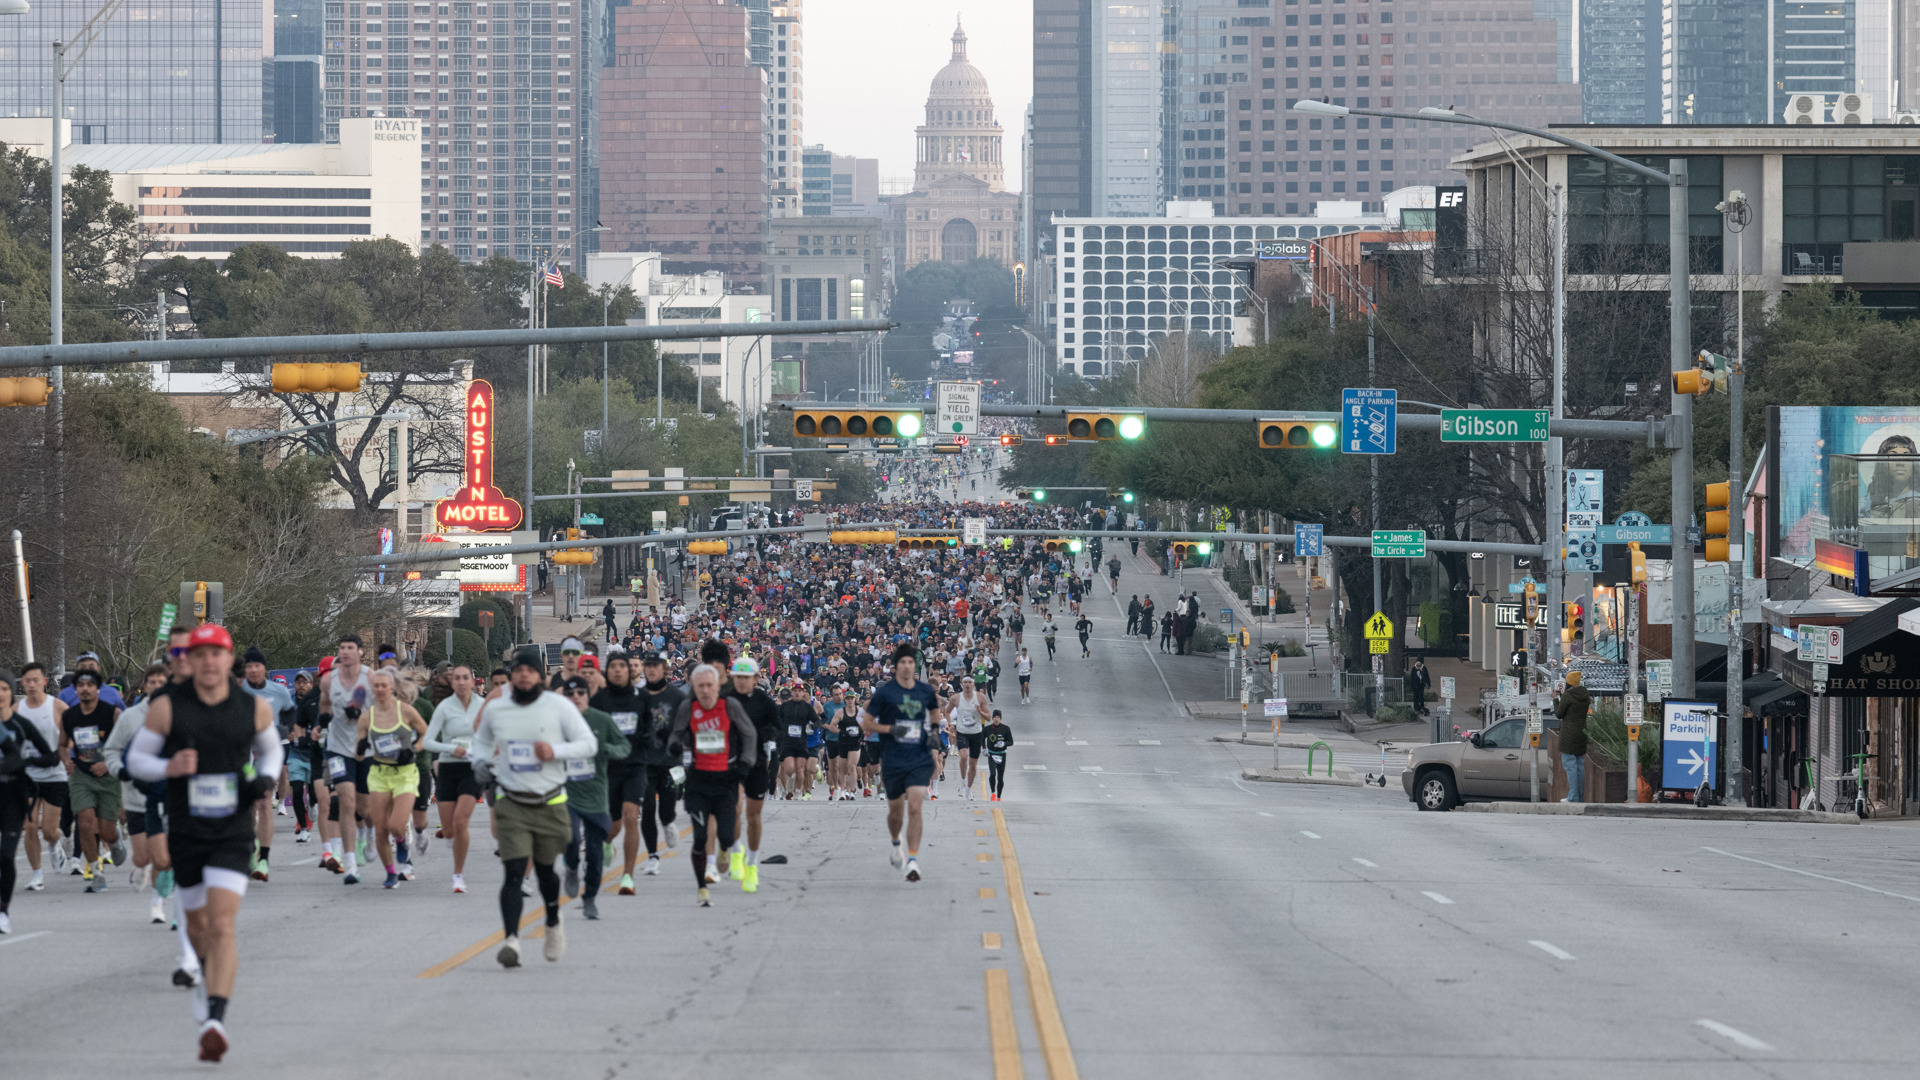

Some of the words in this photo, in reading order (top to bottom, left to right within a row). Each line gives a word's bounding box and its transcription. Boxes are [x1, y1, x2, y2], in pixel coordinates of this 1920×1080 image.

[374, 120, 418, 131] HYATT
[374, 133, 418, 141] REGENCY
[1440, 192, 1464, 207] EF
[947, 405, 970, 413] YIELD
[1442, 420, 1450, 431] E
[1455, 416, 1518, 435] Gibson
[1534, 413, 1546, 423] ST
[1856, 416, 1874, 424] YOU
[1530, 428, 1547, 439] 100
[342, 437, 380, 446] AUSIN
[471, 392, 487, 502] AUSTIN
[344, 448, 378, 458] MEL
[444, 505, 510, 522] MOTEL
[1389, 533, 1412, 542] James
[1615, 529, 1651, 540] Gibson
[1374, 546, 1385, 554] The
[1387, 546, 1406, 554] Circle
[1498, 607, 1520, 624] THE
[1696, 617, 1728, 632] LUB
[1830, 678, 1868, 689] HAT
[1674, 712, 1706, 722] Public
[1670, 724, 1704, 734] Parkin
